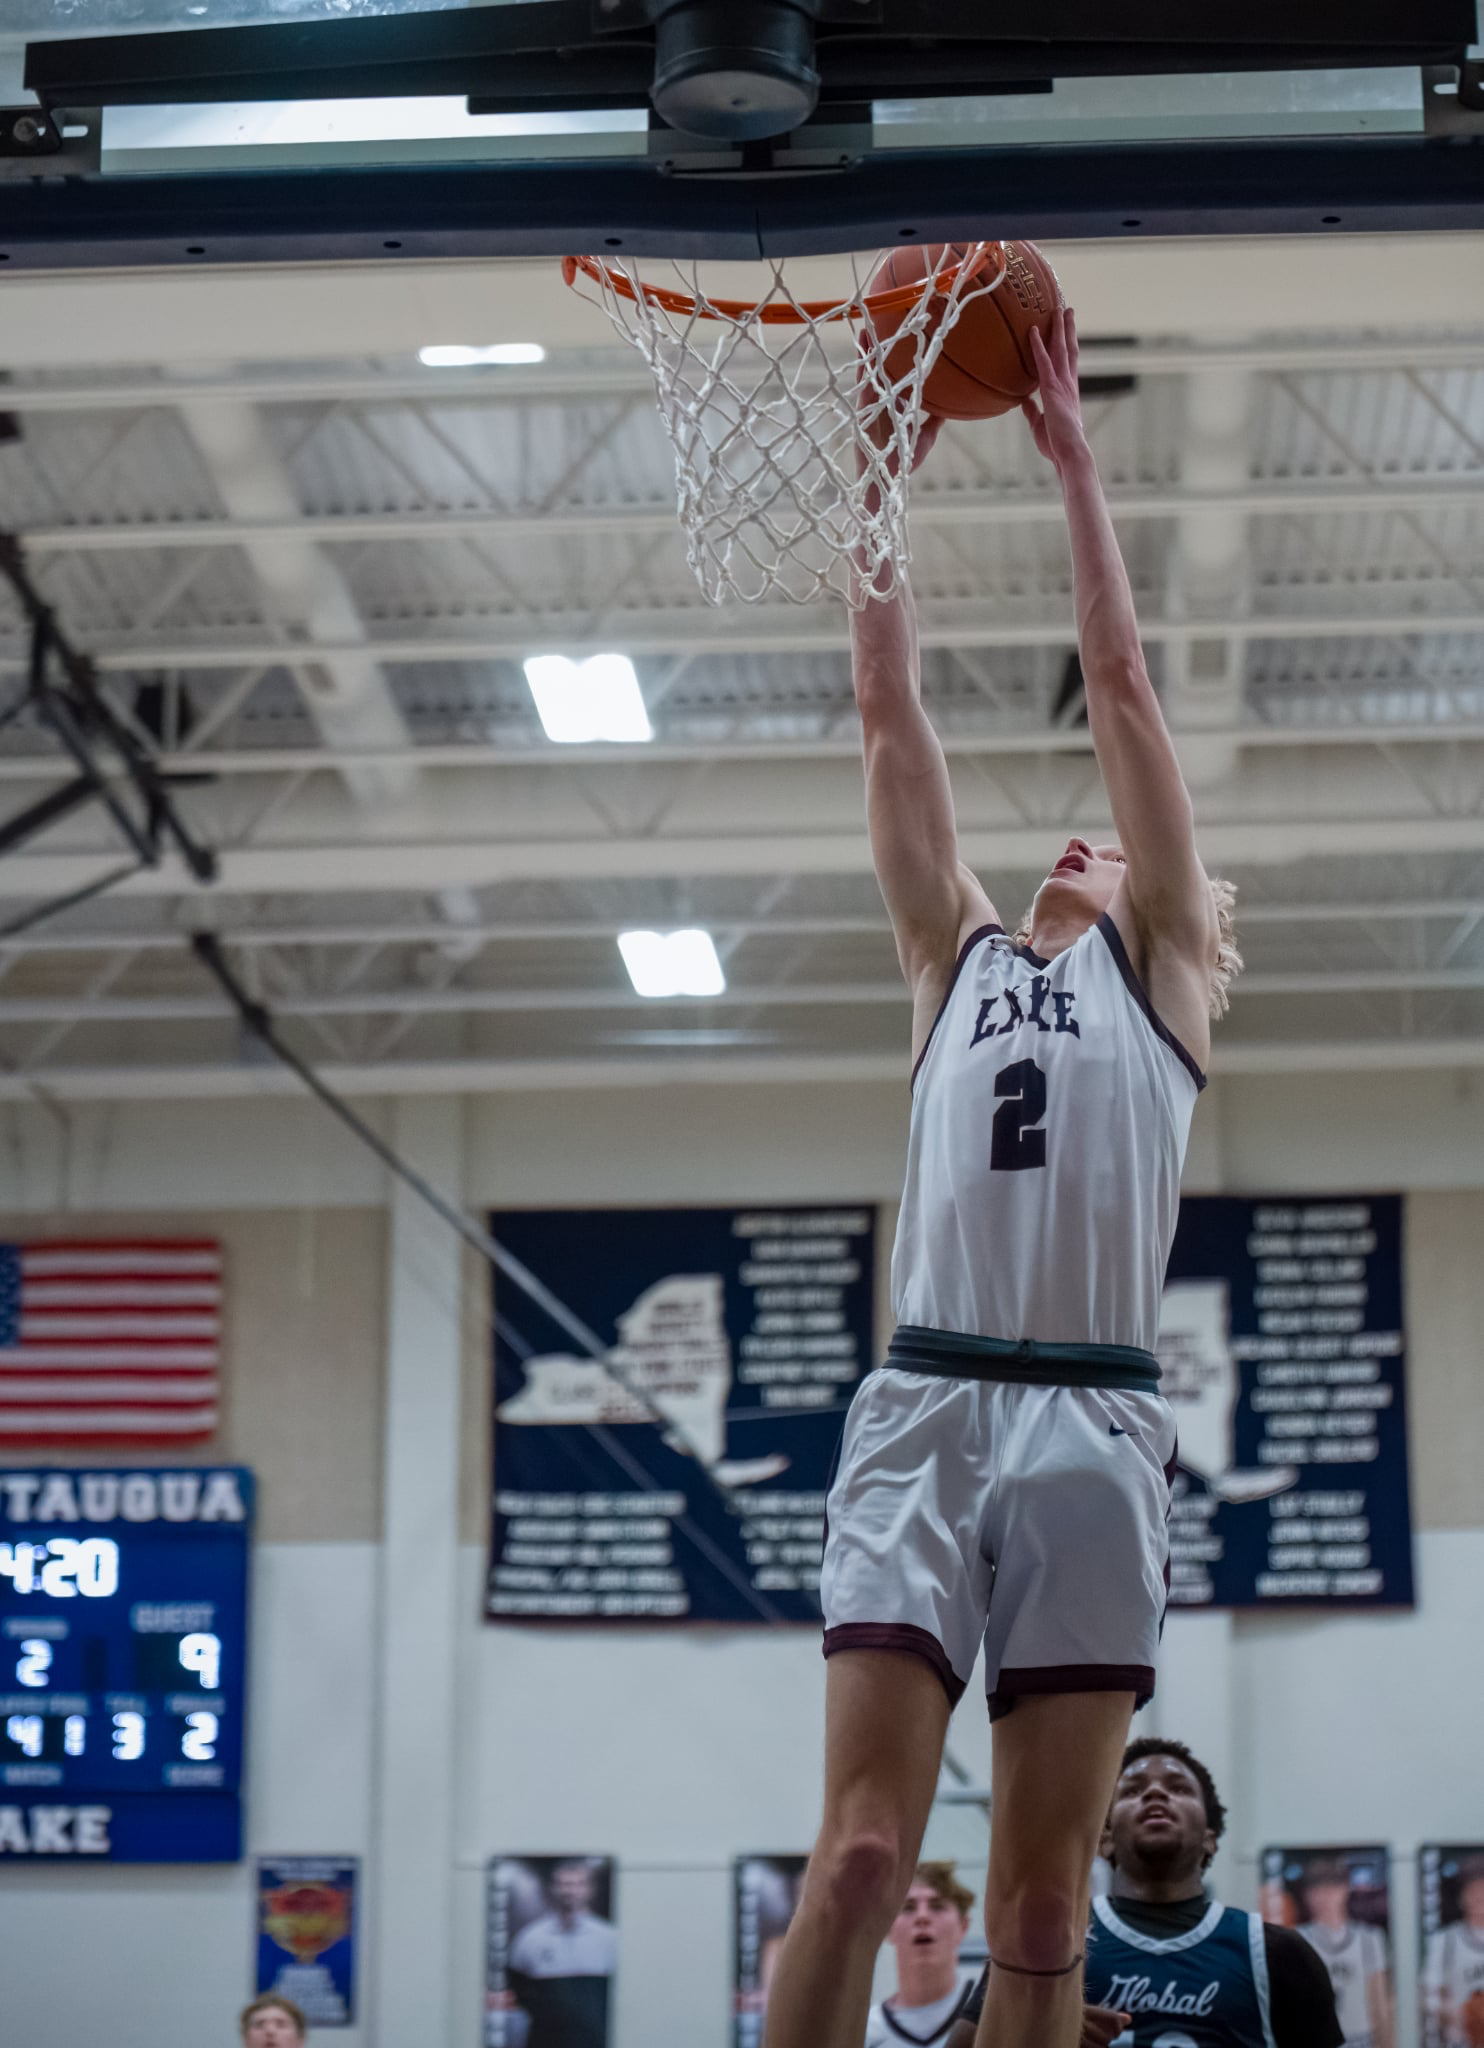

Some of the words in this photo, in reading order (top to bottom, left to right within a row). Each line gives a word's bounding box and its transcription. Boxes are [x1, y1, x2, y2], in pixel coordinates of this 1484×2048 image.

[990, 1058, 1047, 1171] 2
[1, 1472, 244, 1522] TAUQUA
[0, 1537, 119, 1598] 4:20
[16, 1638, 53, 1687] 2
[178, 1632, 222, 1689] 9
[112, 1711, 146, 1760] 3
[181, 1711, 219, 1760] 2
[0, 1805, 111, 1854] AKE
